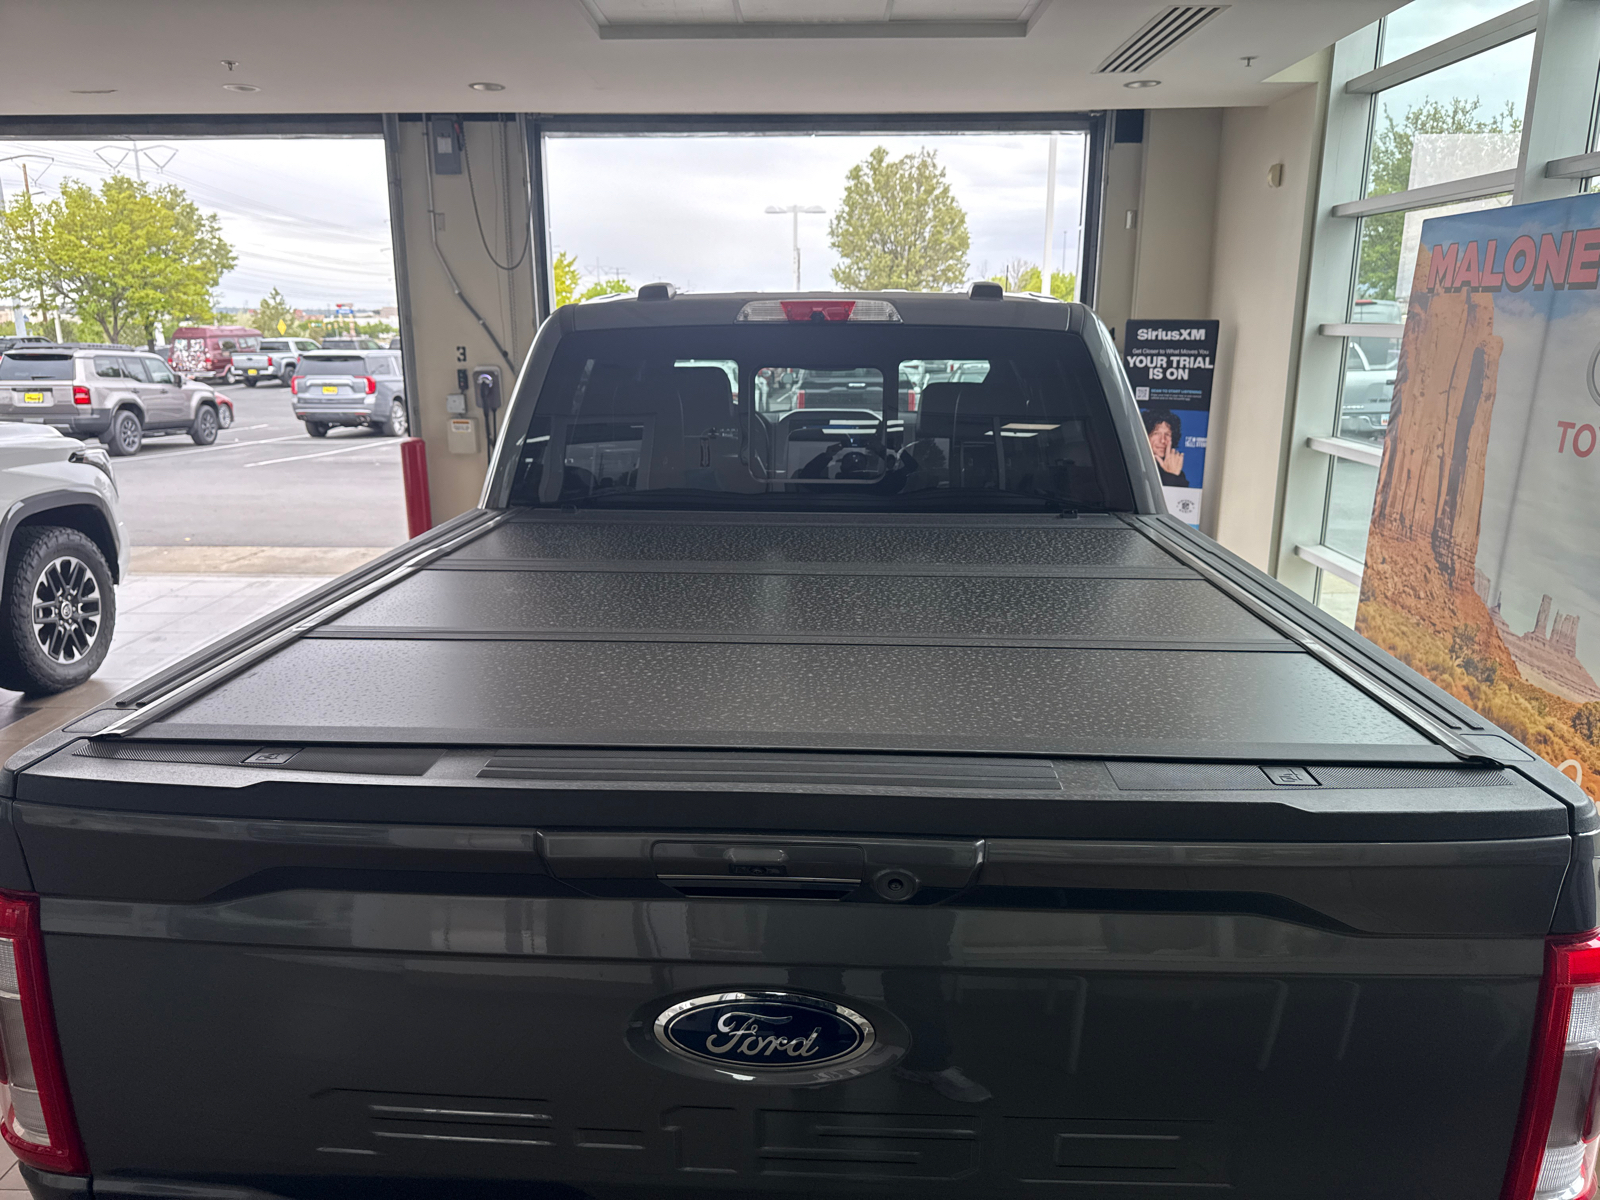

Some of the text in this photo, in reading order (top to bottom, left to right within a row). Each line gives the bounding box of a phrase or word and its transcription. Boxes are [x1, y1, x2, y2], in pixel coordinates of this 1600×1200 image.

[1427, 228, 1600, 293] MALONE
[1137, 328, 1206, 340] SiriusXM
[456, 346, 467, 362] 3
[1127, 356, 1214, 369] YOUR TRIAL
[1149, 368, 1189, 380] IS ON
[1557, 420, 1600, 458] TO
[706, 1011, 822, 1057] Ford
